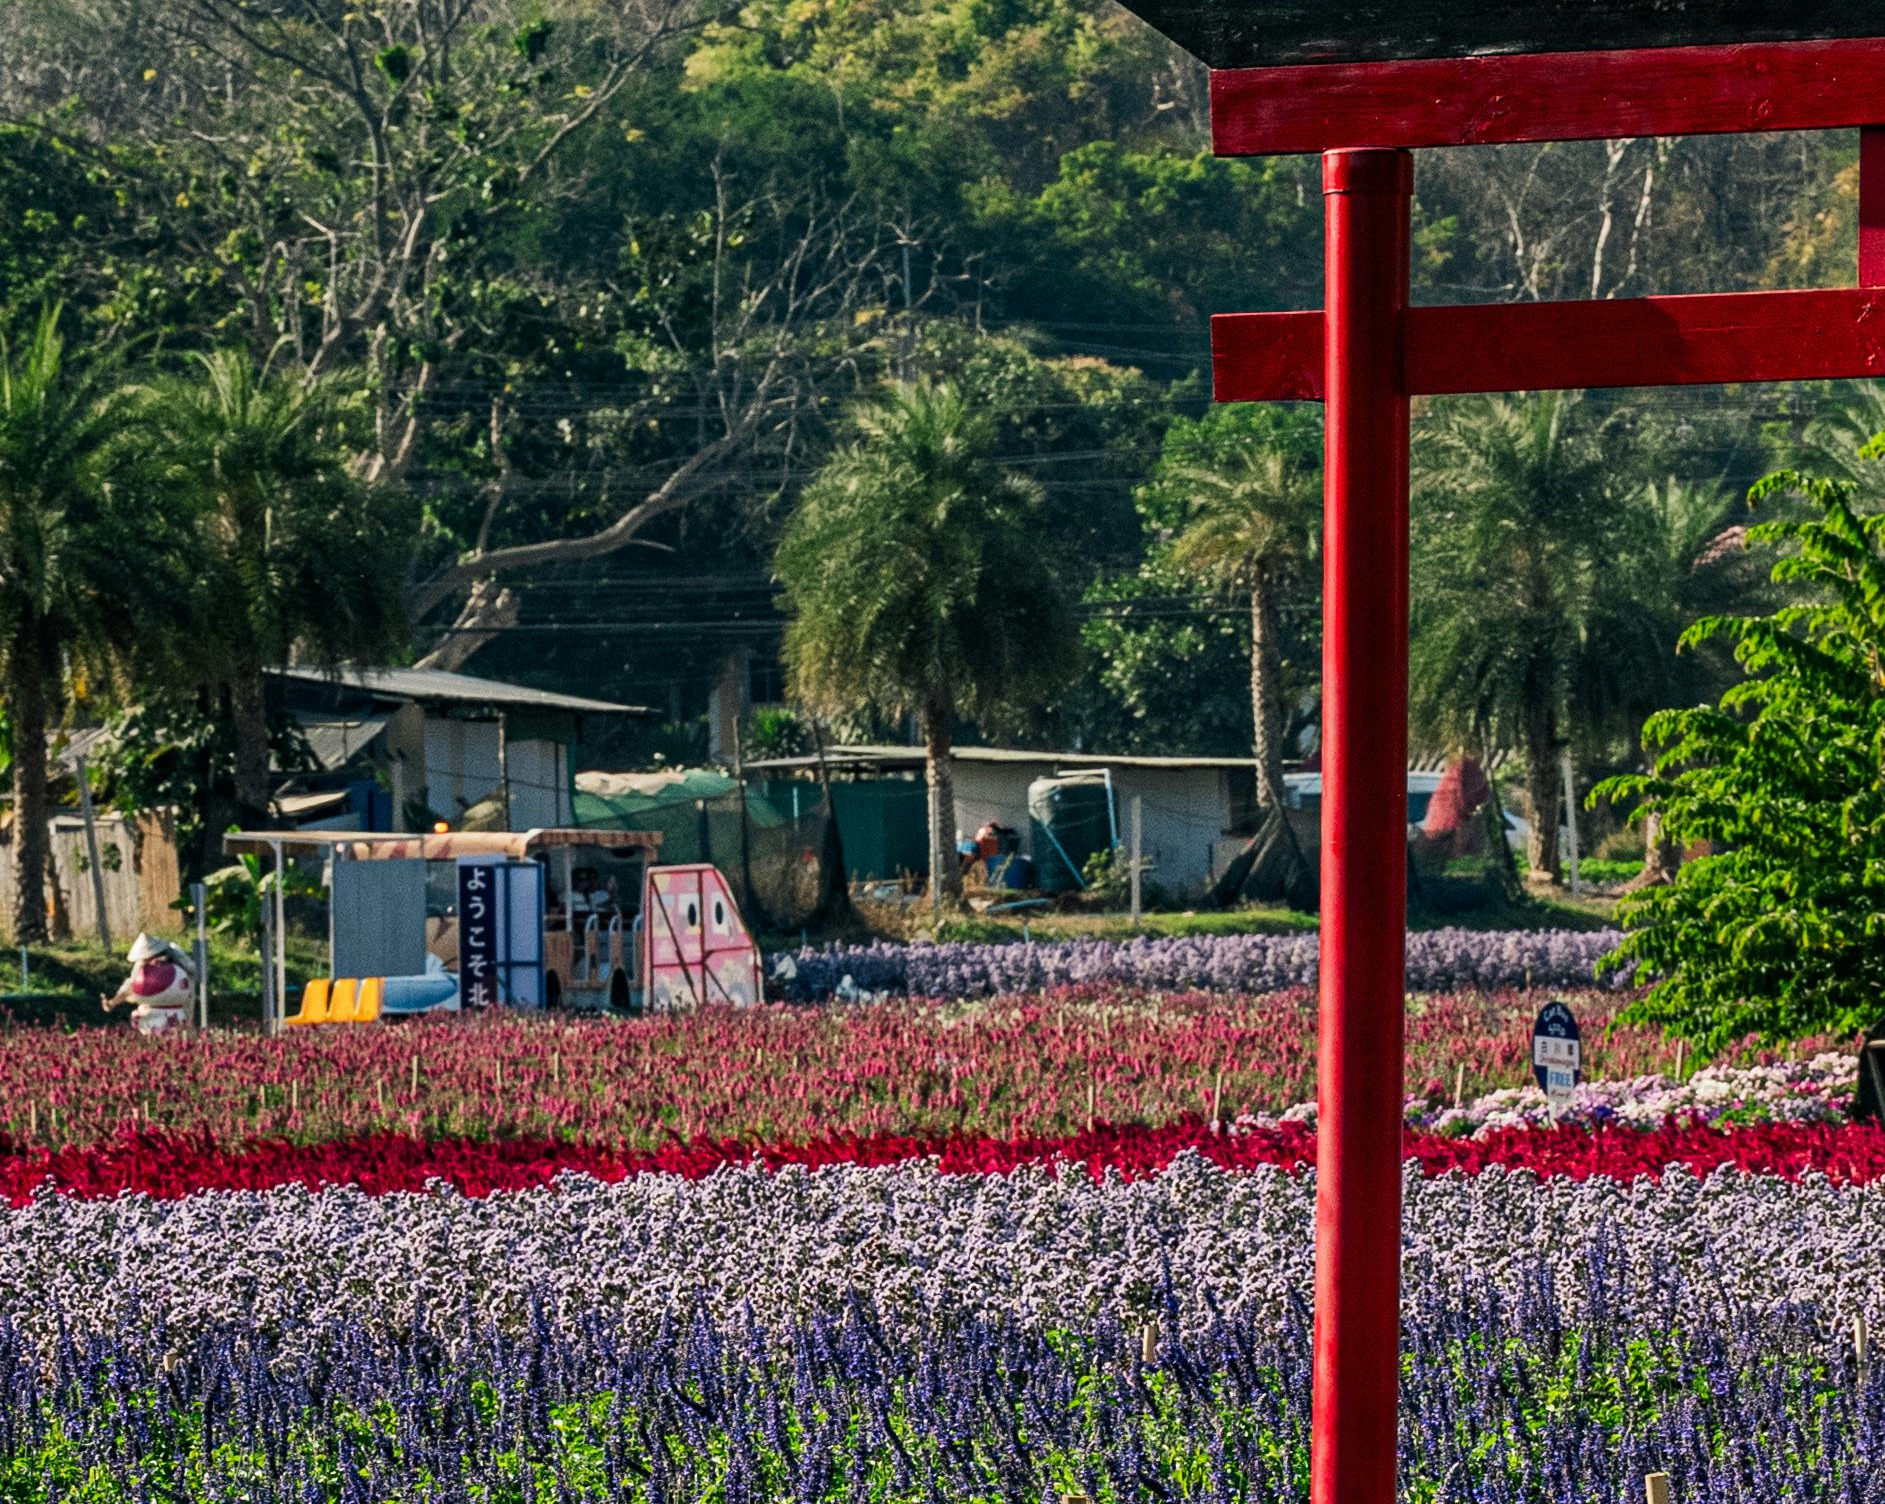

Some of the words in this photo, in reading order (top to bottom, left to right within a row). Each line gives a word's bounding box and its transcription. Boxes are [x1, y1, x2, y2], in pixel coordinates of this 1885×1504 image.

[467, 867, 489, 1006] ようこそ北
[1549, 1071, 1571, 1087] FREE
